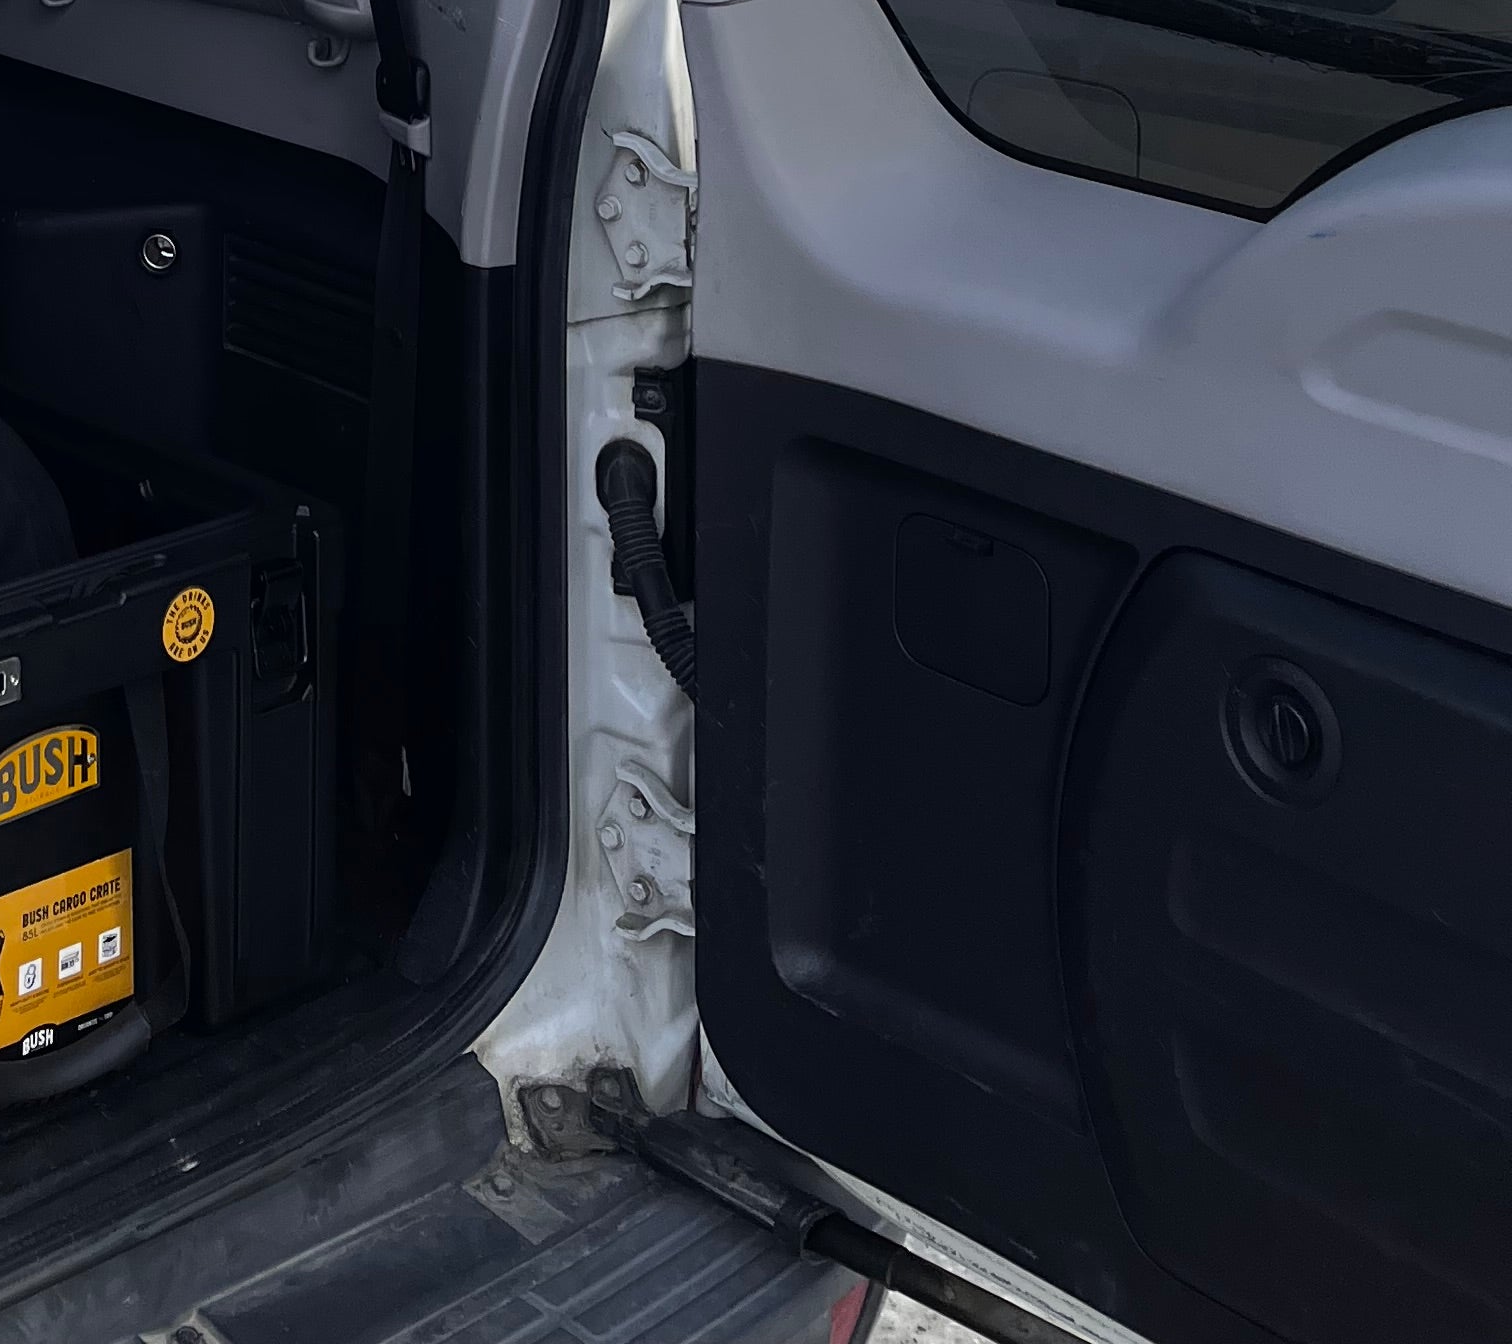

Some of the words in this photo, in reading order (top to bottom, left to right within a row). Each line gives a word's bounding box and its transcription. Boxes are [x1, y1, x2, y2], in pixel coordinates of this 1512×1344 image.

[166, 602, 180, 625] THE
[182, 591, 211, 611] DRINKS
[169, 642, 184, 658] ARE
[187, 644, 198, 657] ON
[199, 629, 210, 644] US
[22, 904, 49, 929] BUSH
[52, 890, 87, 916] CARGO
[90, 876, 121, 902] CRATE
[22, 927, 39, 942] 85L
[22, 1028, 54, 1056] BUSH
